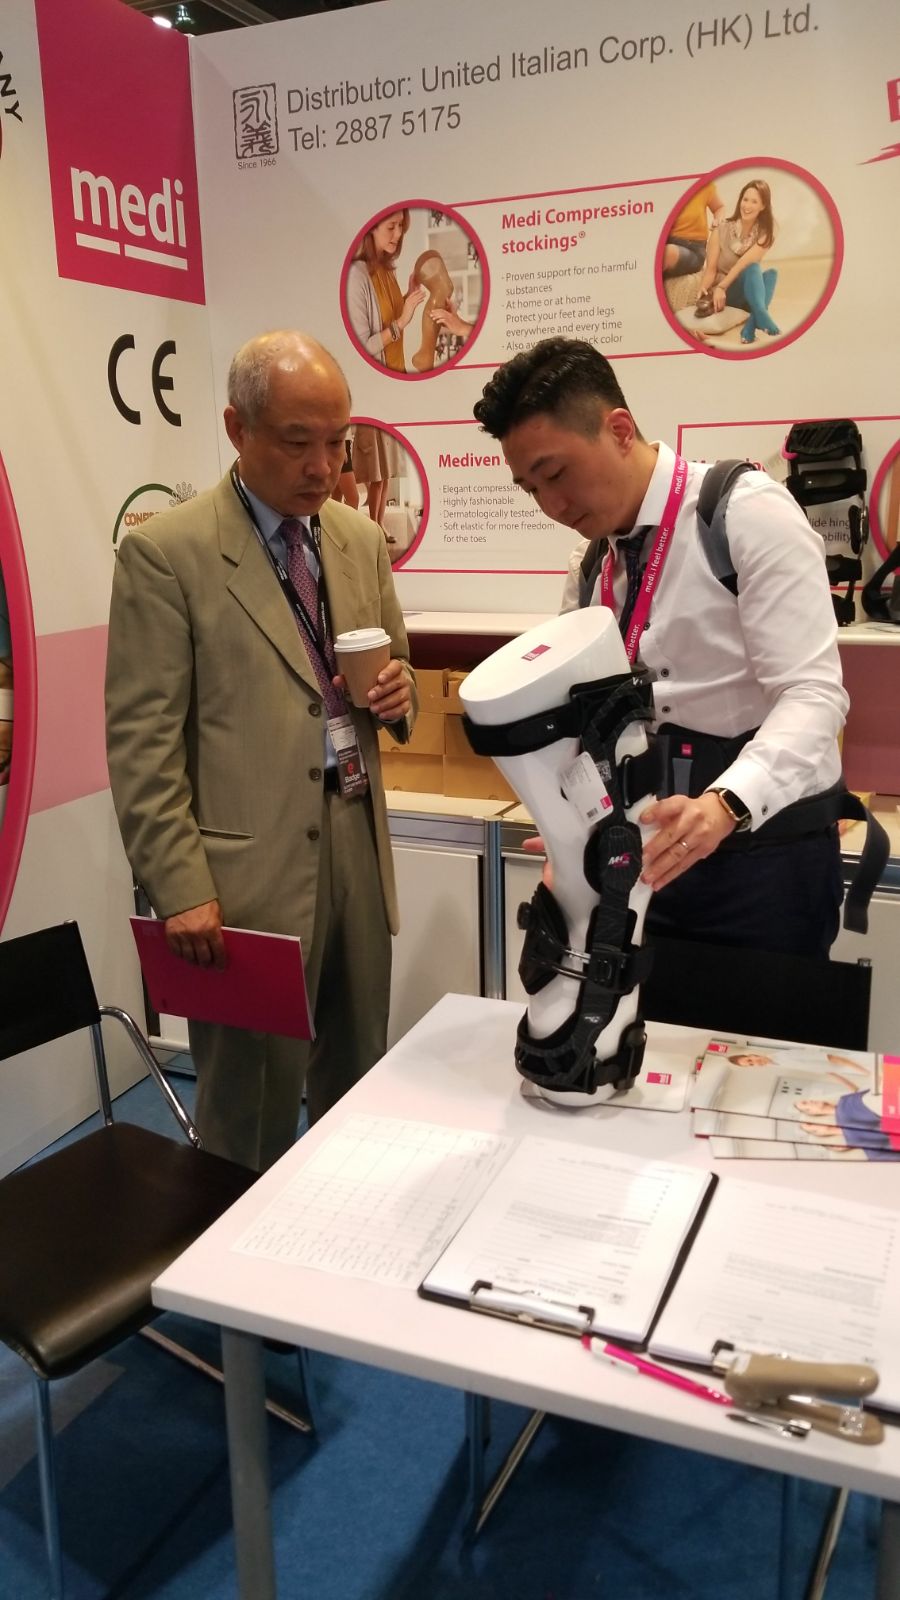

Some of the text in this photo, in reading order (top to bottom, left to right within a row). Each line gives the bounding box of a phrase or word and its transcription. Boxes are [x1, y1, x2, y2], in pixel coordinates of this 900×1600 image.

[288, 3, 819, 114] Distributor: United Italian Corp. (HK) Ltd.
[288, 103, 461, 152] Tel: 2887 5175
[237, 157, 277, 170] Since 1966
[70, 166, 187, 249] medi
[502, 200, 654, 230] Medi Compression
[505, 260, 637, 282] Proven support for no harmful
[505, 284, 553, 295] substances
[517, 298, 542, 308] home
[544, 298, 553, 306] or
[555, 297, 564, 305] at
[565, 295, 591, 304] home
[505, 306, 615, 325] Protect your feet and legs
[505, 319, 623, 338] everywhere and every time
[506, 340, 525, 351] Also
[600, 333, 622, 344] color
[107, 333, 182, 427] CE
[438, 453, 501, 468] Mediven
[442, 483, 523, 495] Elegant compression
[443, 496, 515, 508] Highly fashionable
[443, 509, 508, 519] Dermatologically
[443, 521, 555, 531] Soft elastic for more freedom
[809, 517, 850, 530] lide hing
[443, 534, 487, 543] for the toes
[656, 527, 670, 552] better.
[822, 532, 851, 544] obility
